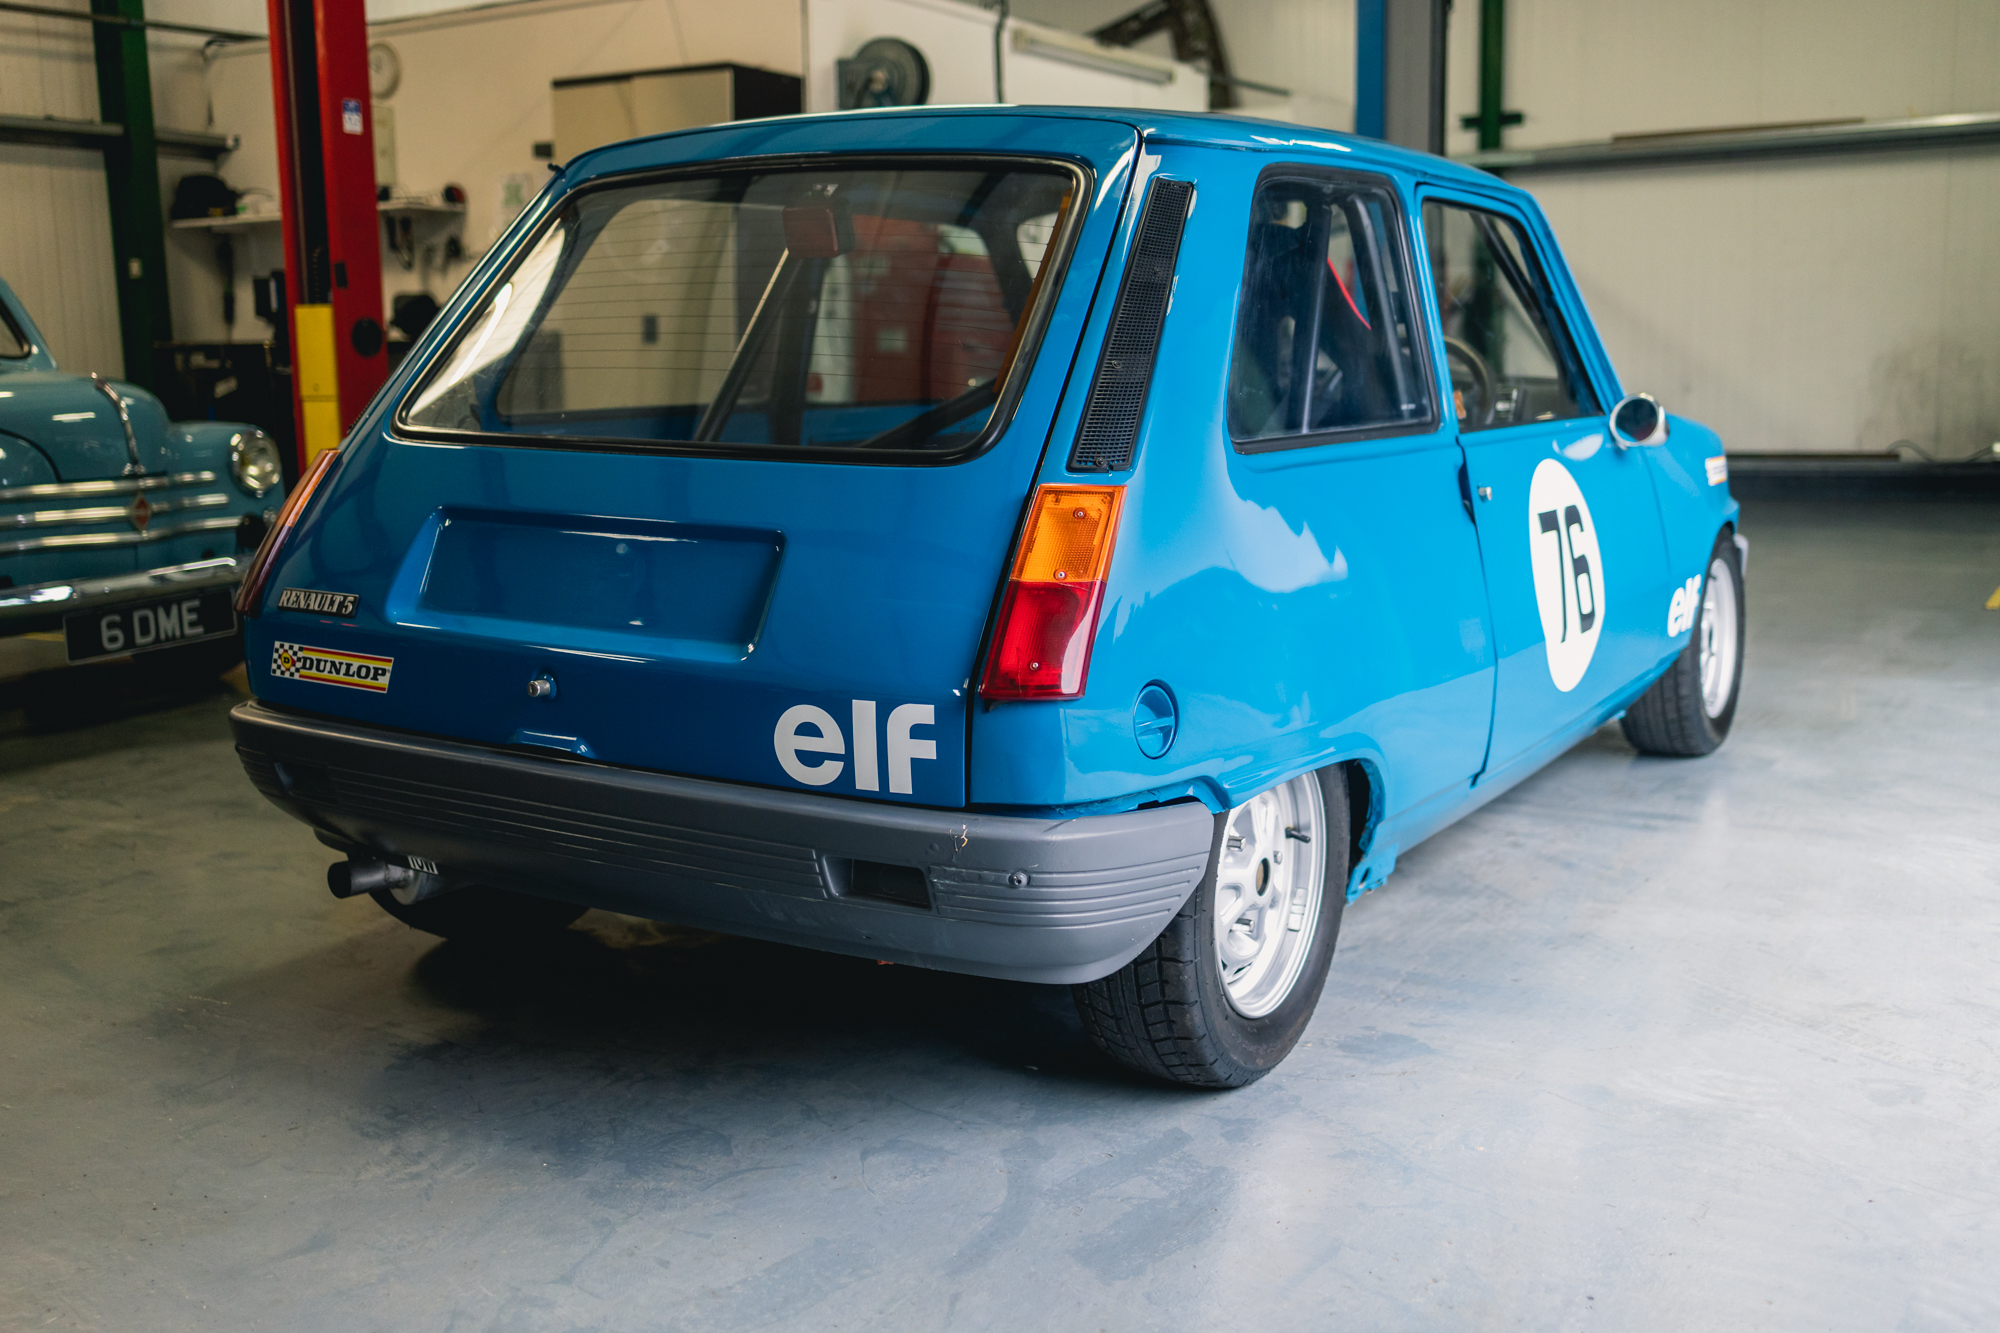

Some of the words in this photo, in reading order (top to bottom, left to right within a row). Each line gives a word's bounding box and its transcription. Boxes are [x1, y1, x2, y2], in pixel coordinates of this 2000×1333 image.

[278, 589, 343, 613] RENAULT
[342, 596, 355, 615] 5
[1537, 504, 1596, 643] 76
[101, 614, 125, 651] 6
[132, 600, 205, 647] DME
[1667, 573, 1702, 638] elf
[300, 656, 387, 681] DUNLOP
[773, 699, 937, 795] elf
